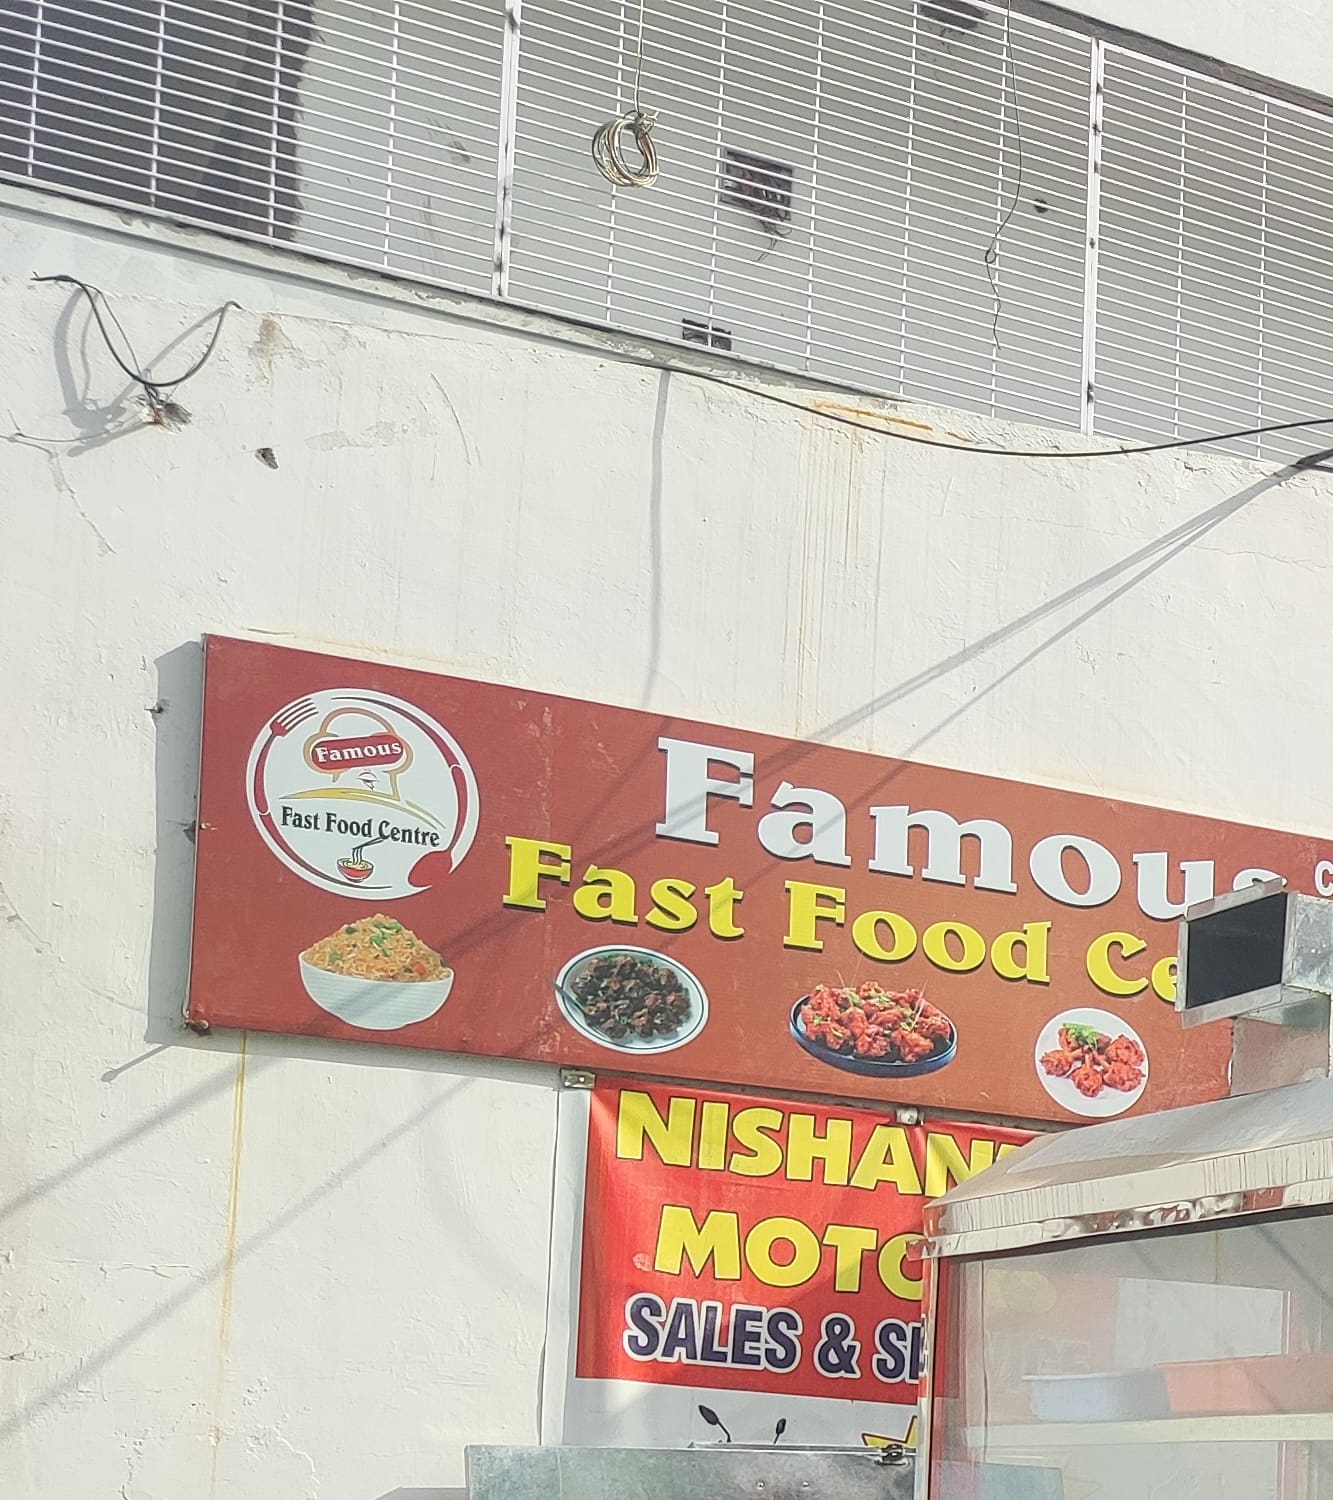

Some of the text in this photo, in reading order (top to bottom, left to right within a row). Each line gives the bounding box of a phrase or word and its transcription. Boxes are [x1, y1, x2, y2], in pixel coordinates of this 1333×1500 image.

[315, 742, 402, 763] Famous
[281, 806, 440, 847] Fast Food Centre
[503, 836, 1178, 1005] Fast Food Ce
[616, 1090, 1022, 1198] NISHAN
[653, 1204, 923, 1301] MOTO
[624, 1293, 802, 1371] SALES
[814, 1315, 861, 1378] &
